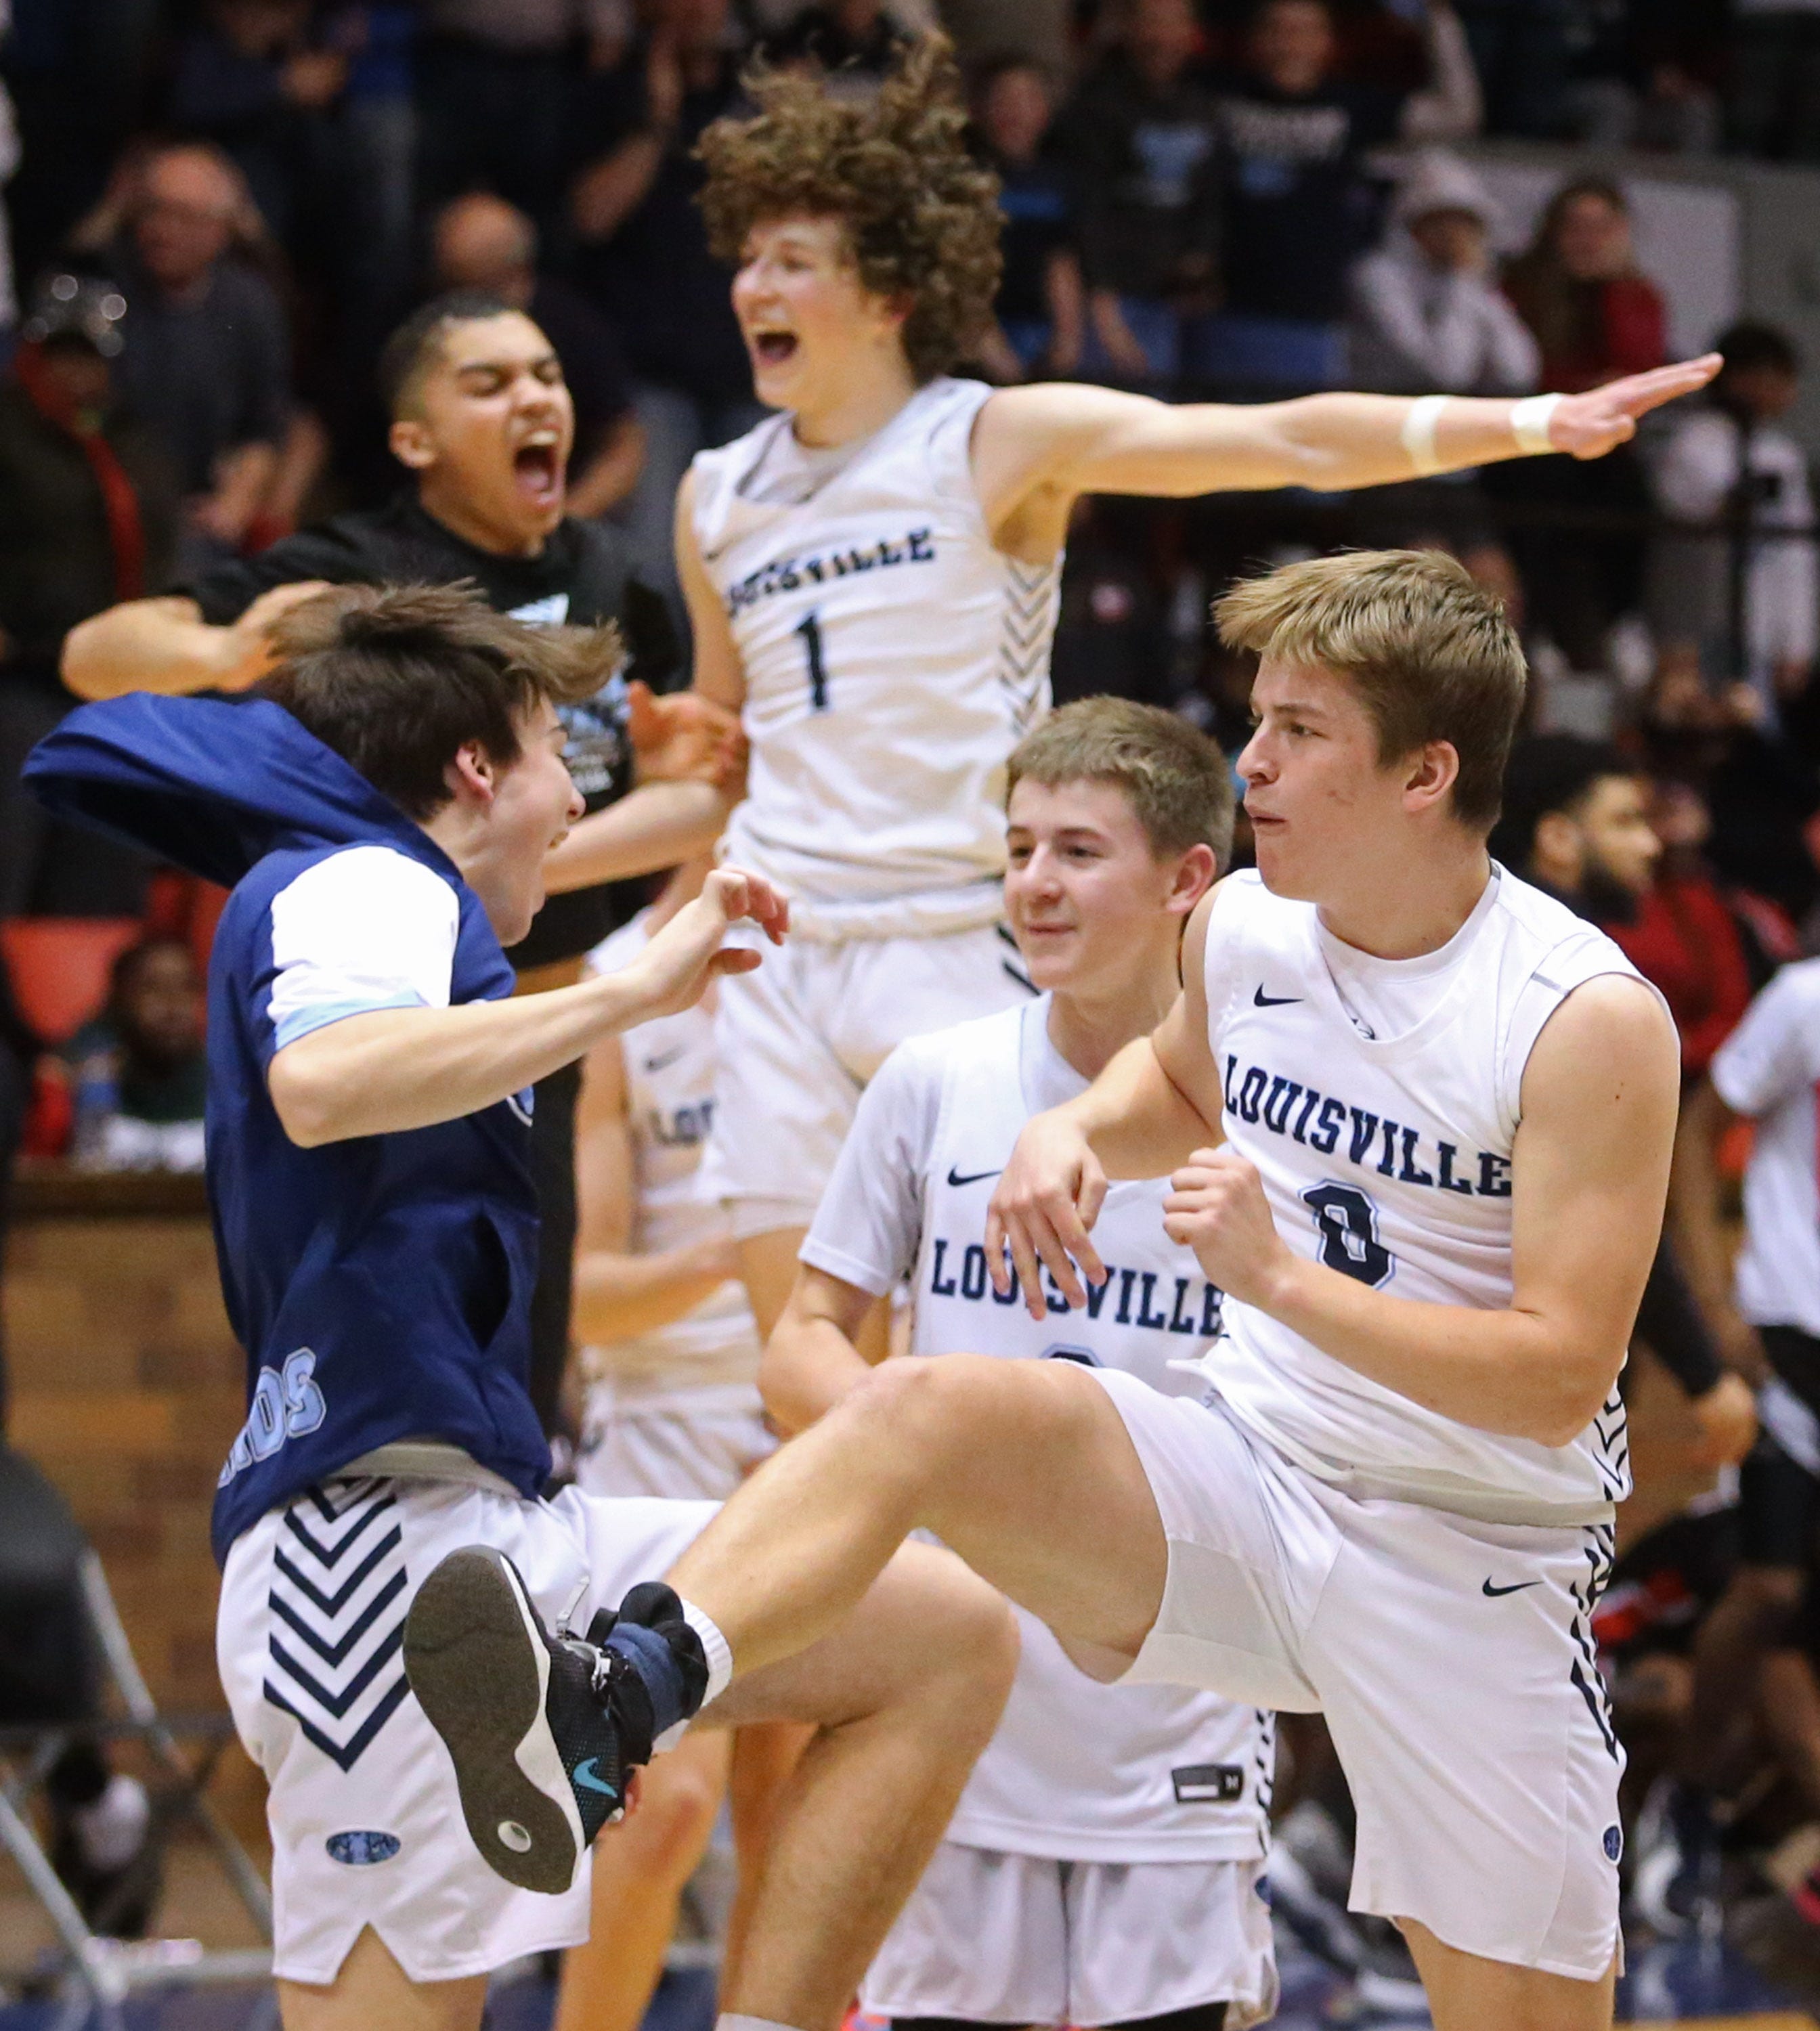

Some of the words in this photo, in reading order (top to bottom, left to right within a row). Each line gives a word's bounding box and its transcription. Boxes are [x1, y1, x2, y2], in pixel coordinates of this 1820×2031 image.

[729, 527, 936, 619] UISVILLE
[795, 608, 829, 709] 1
[1224, 1053, 1511, 1196] LOUISVILLE
[1298, 1178, 1396, 1290] 0
[931, 1239, 1231, 1338] LOUSVILLE
